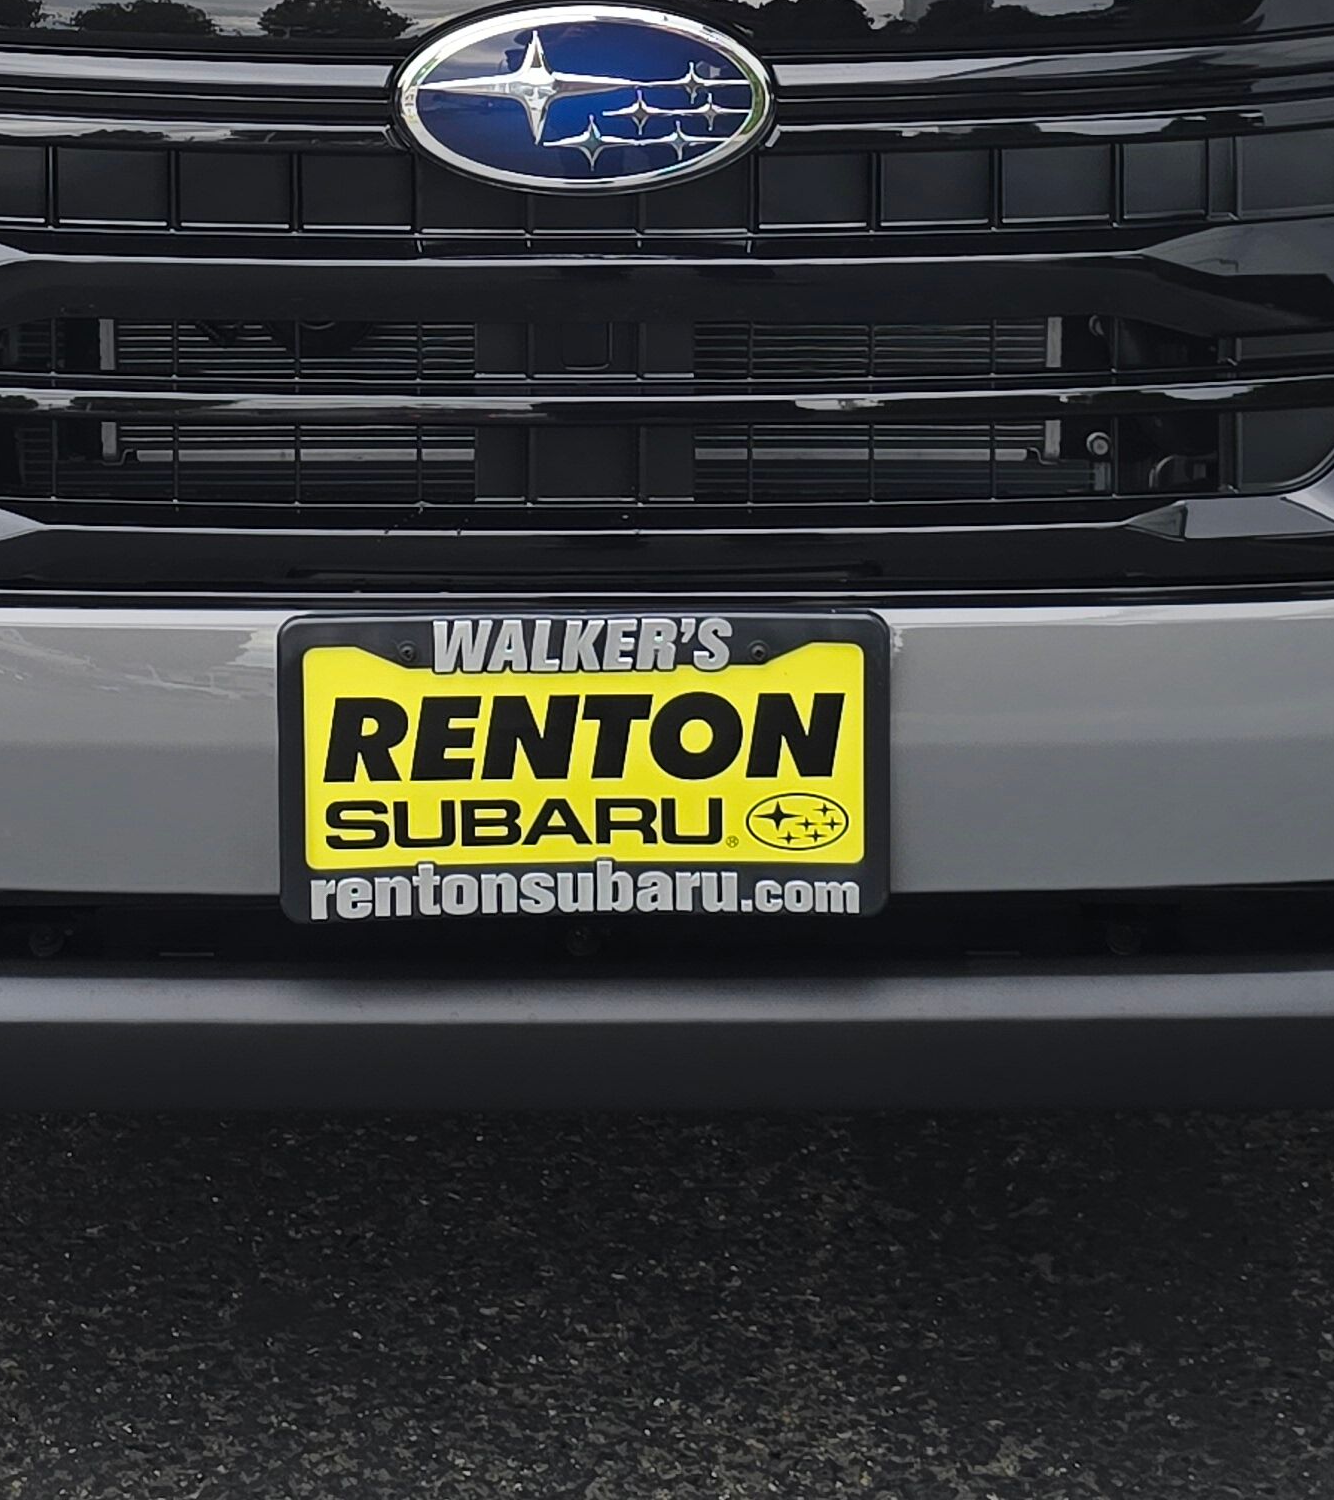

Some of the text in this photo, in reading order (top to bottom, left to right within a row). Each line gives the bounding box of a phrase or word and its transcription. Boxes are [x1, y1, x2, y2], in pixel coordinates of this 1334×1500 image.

[433, 617, 733, 674] WALKER'S
[323, 691, 846, 784] RENTON
[310, 859, 860, 921] rentonsubaru.com
